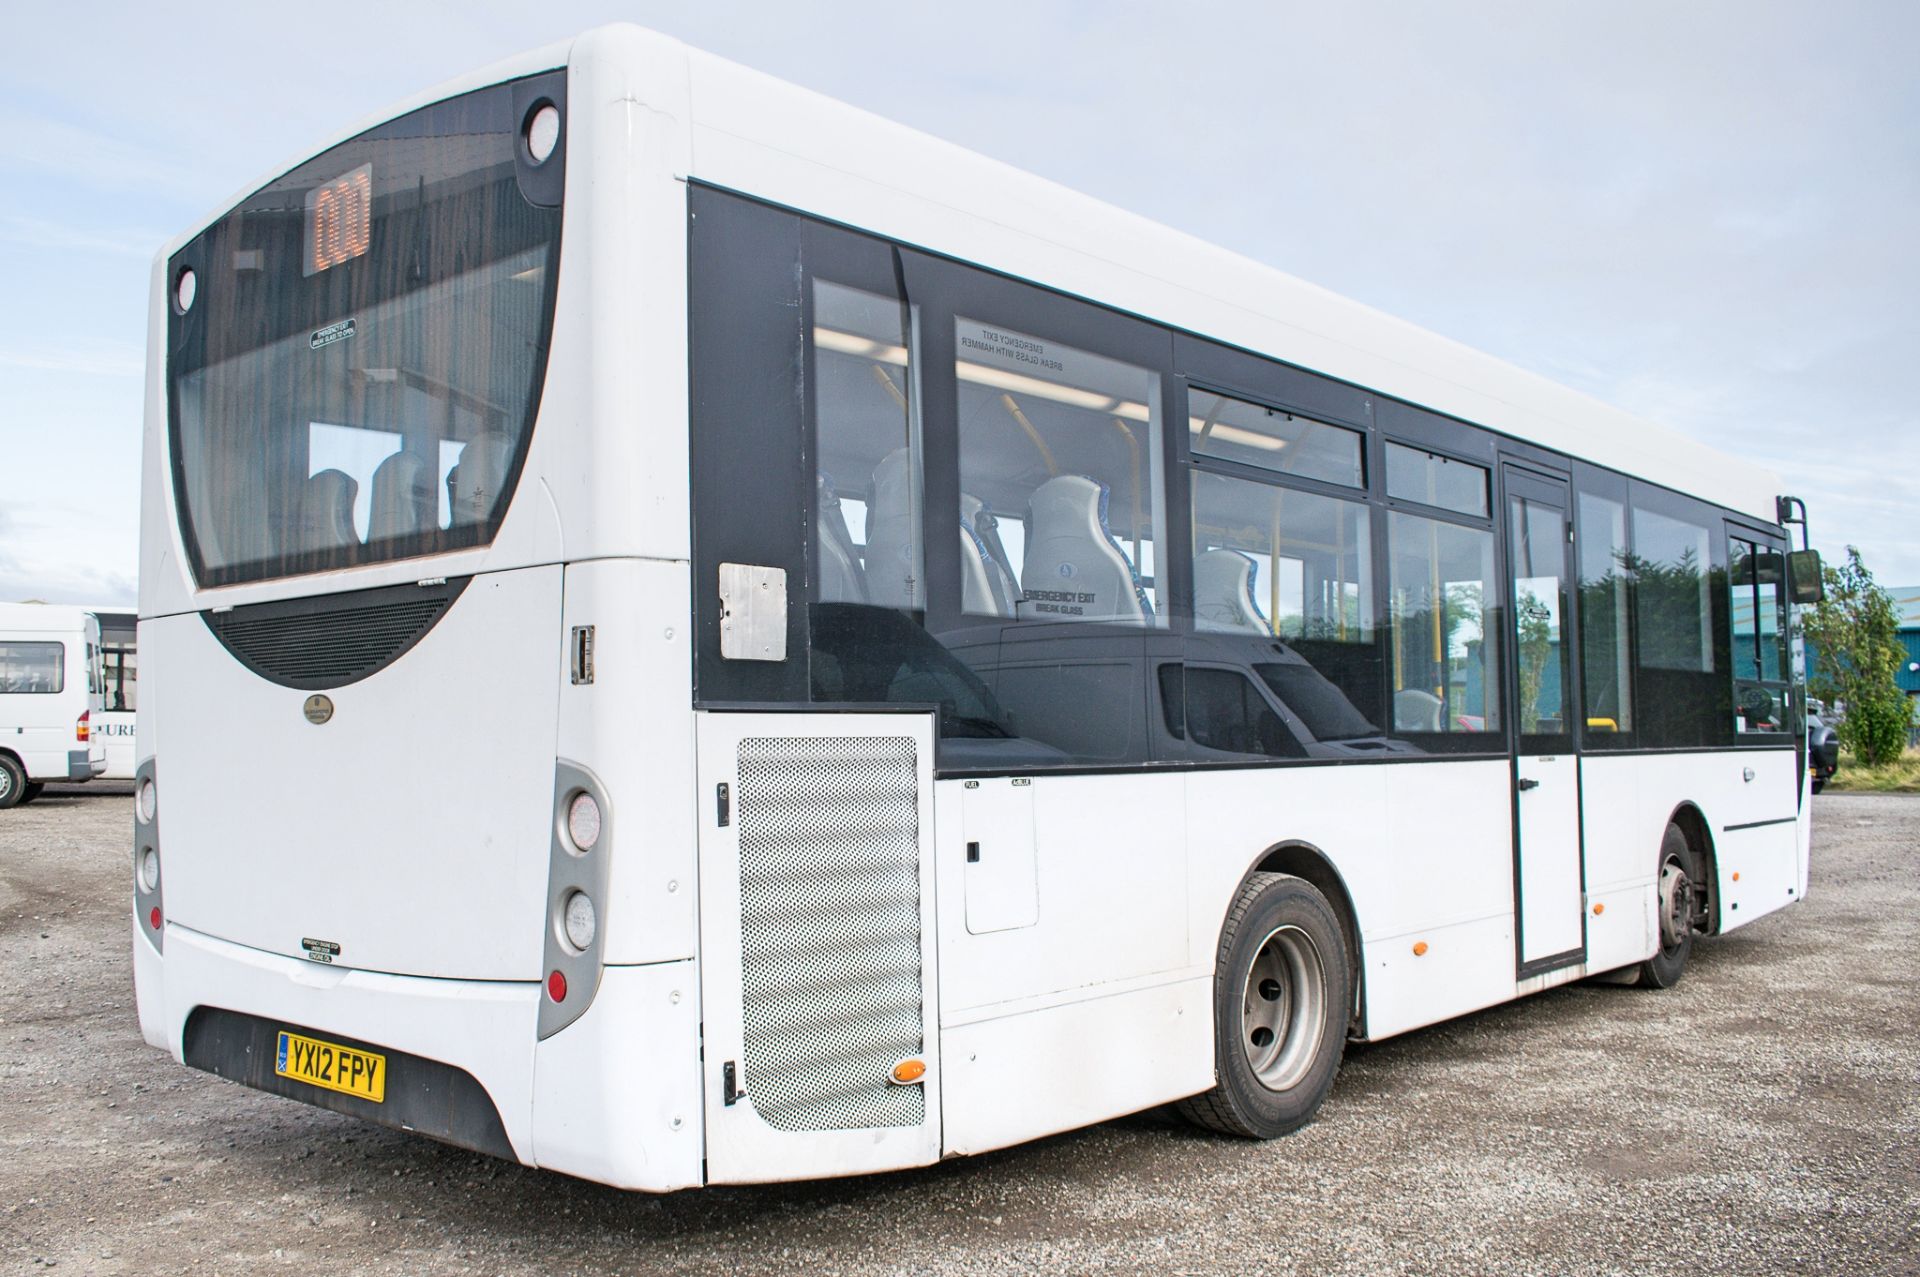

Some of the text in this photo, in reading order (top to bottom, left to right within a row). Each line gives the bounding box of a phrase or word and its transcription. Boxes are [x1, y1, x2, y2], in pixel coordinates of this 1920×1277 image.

[1023, 589, 1096, 603] EMERGENCY EXIT
[1035, 603, 1083, 616] BREAK GLASS
[965, 780, 978, 789] FUEL
[293, 1039, 378, 1093] YX12 FPY
